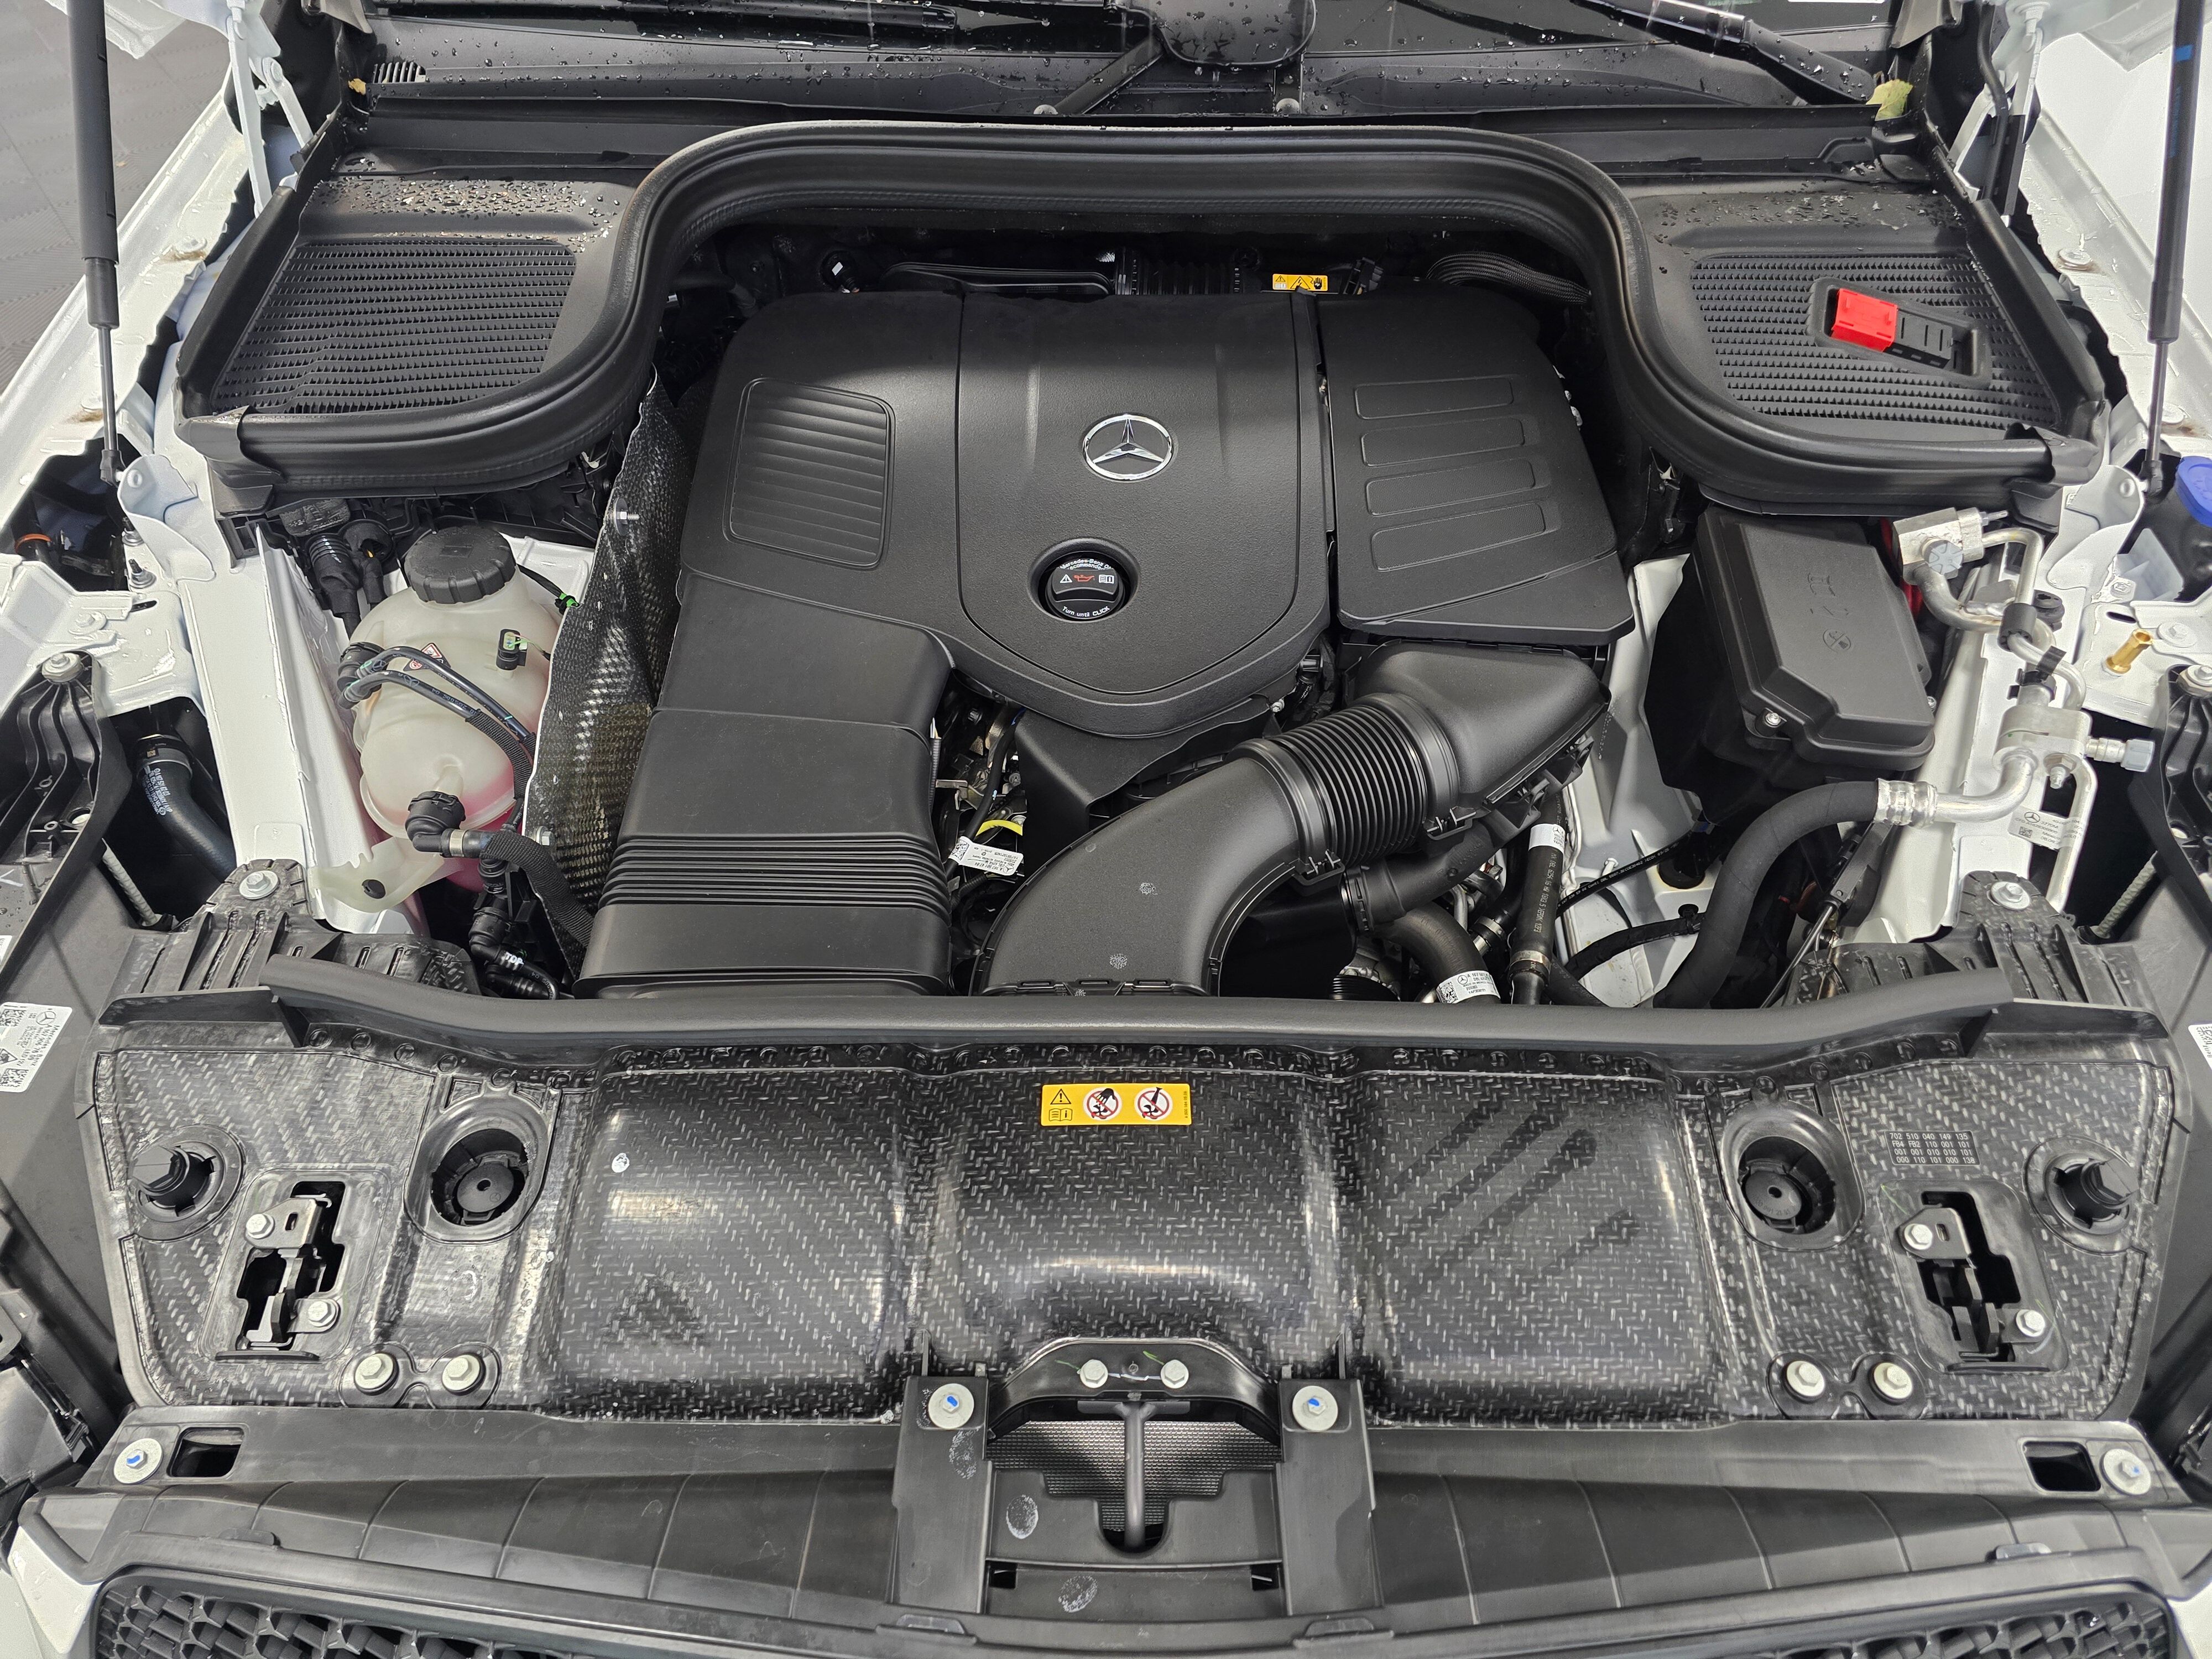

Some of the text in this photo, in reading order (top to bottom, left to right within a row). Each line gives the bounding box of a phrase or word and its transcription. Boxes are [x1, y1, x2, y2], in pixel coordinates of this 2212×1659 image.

[1062, 606, 1074, 615] Turn
[1092, 606, 1110, 616] CLICK
[505, 952, 524, 965] TOP
